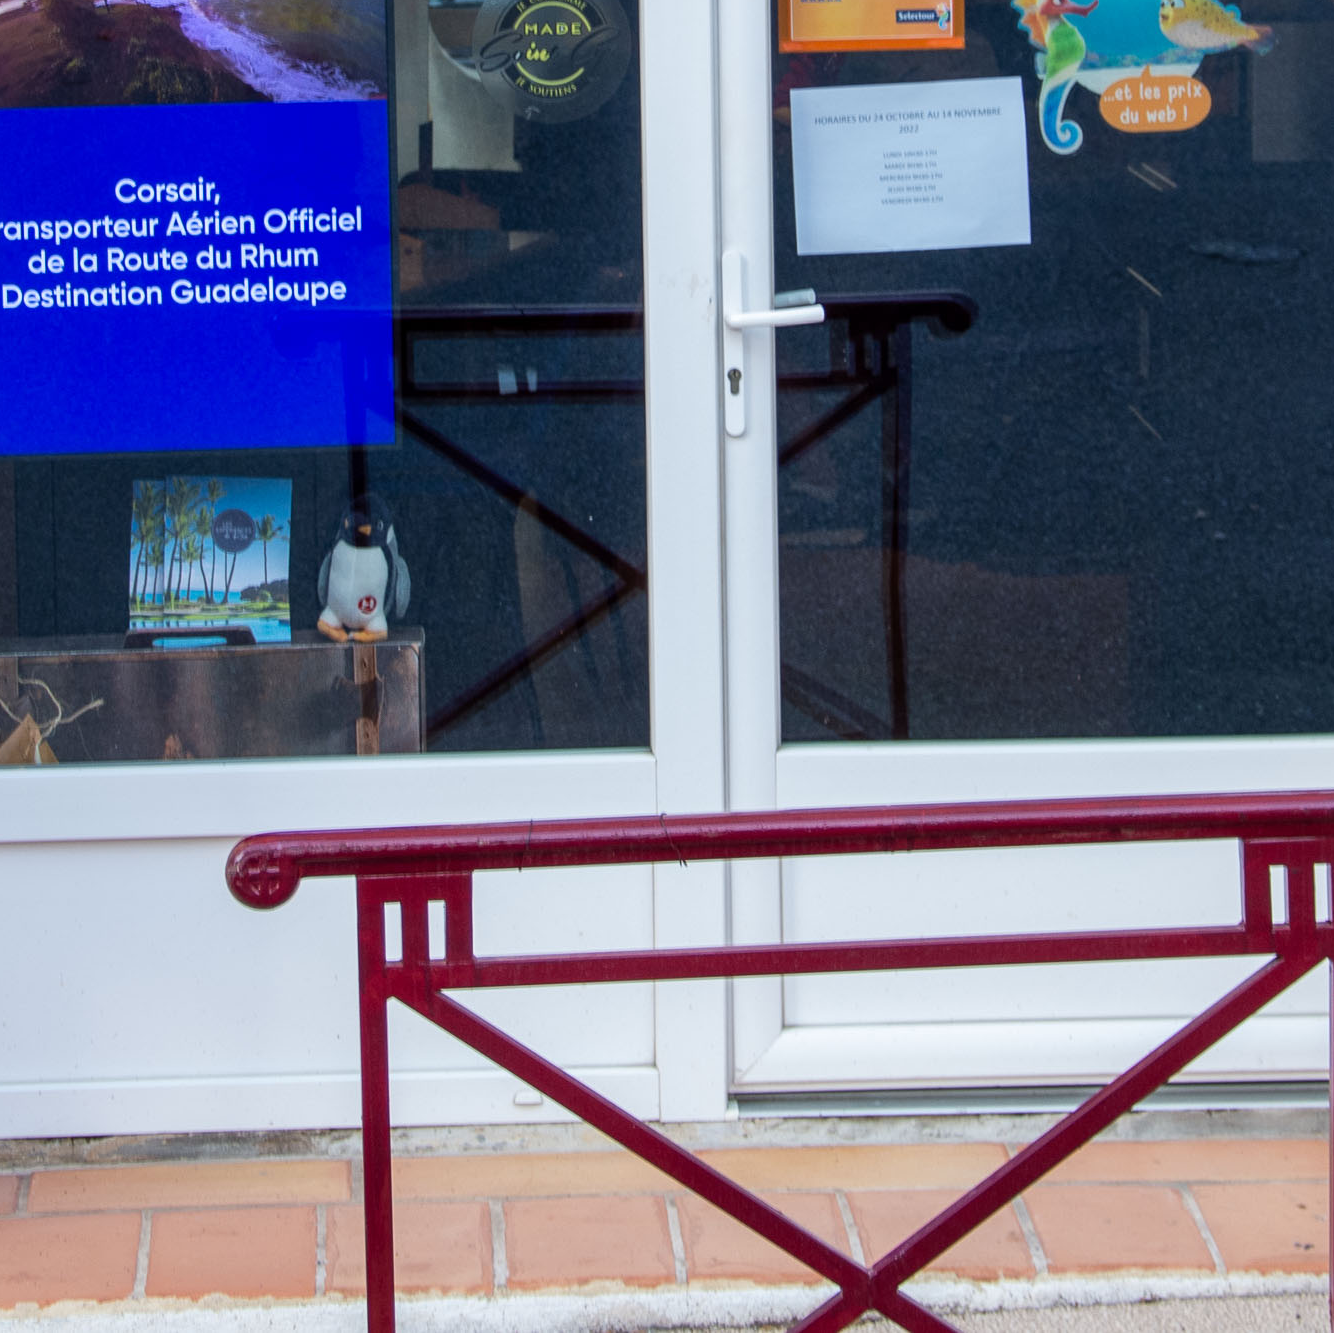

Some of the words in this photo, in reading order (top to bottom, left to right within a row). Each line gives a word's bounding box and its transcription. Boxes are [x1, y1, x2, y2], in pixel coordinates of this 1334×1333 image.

[898, 11, 936, 21] Selectour
[524, 22, 582, 36] MADE
[528, 83, 578, 99] SOUTIENS
[1140, 82, 1162, 100] les
[1168, 80, 1203, 103] prix
[814, 115, 857, 126] HORAIRES
[859, 114, 871, 124] DU
[886, 112, 925, 122] OCTOBRE
[927, 111, 940, 120] AU
[954, 106, 1003, 119] NOVEMBRE
[1120, 106, 1139, 124] du
[1147, 105, 1177, 122] web
[898, 125, 919, 134] 2022
[114, 176, 221, 205] Corsair,
[166, 210, 256, 237] Aérien
[263, 205, 363, 234] Officiel
[28, 249, 65, 274] de
[72, 247, 98, 273] la
[107, 246, 188, 272] Route
[196, 244, 232, 270] du
[241, 242, 319, 268] Rhum
[1, 280, 163, 309] Destination
[170, 276, 347, 307] Guadeloupe
